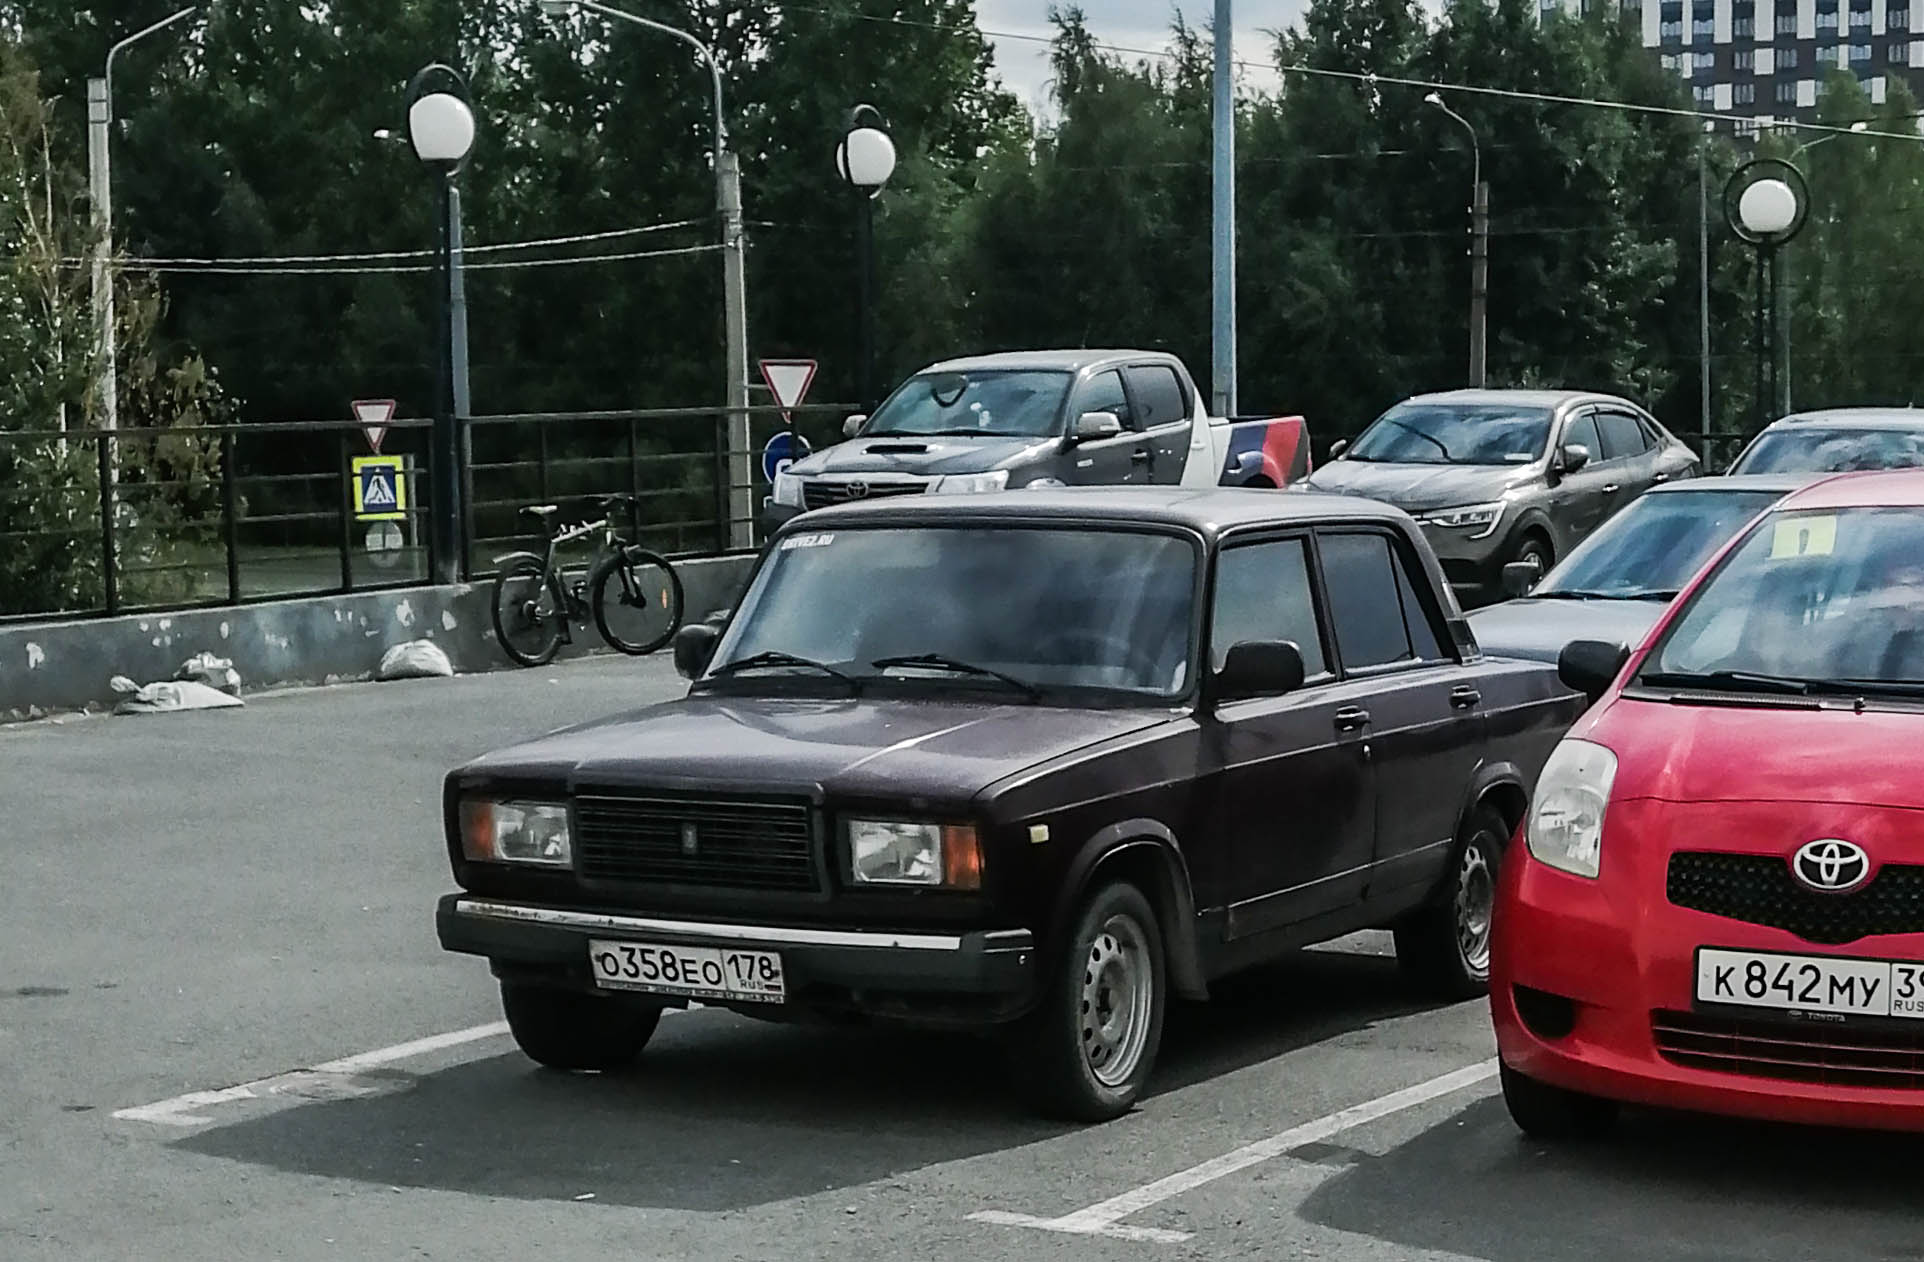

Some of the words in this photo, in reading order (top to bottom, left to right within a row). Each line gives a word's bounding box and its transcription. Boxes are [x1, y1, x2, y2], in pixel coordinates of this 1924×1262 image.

[601, 946, 722, 985] О358ЕО
[727, 954, 774, 980] 178
[740, 979, 764, 989] RUS
[1714, 960, 1880, 1008] К842МУ
